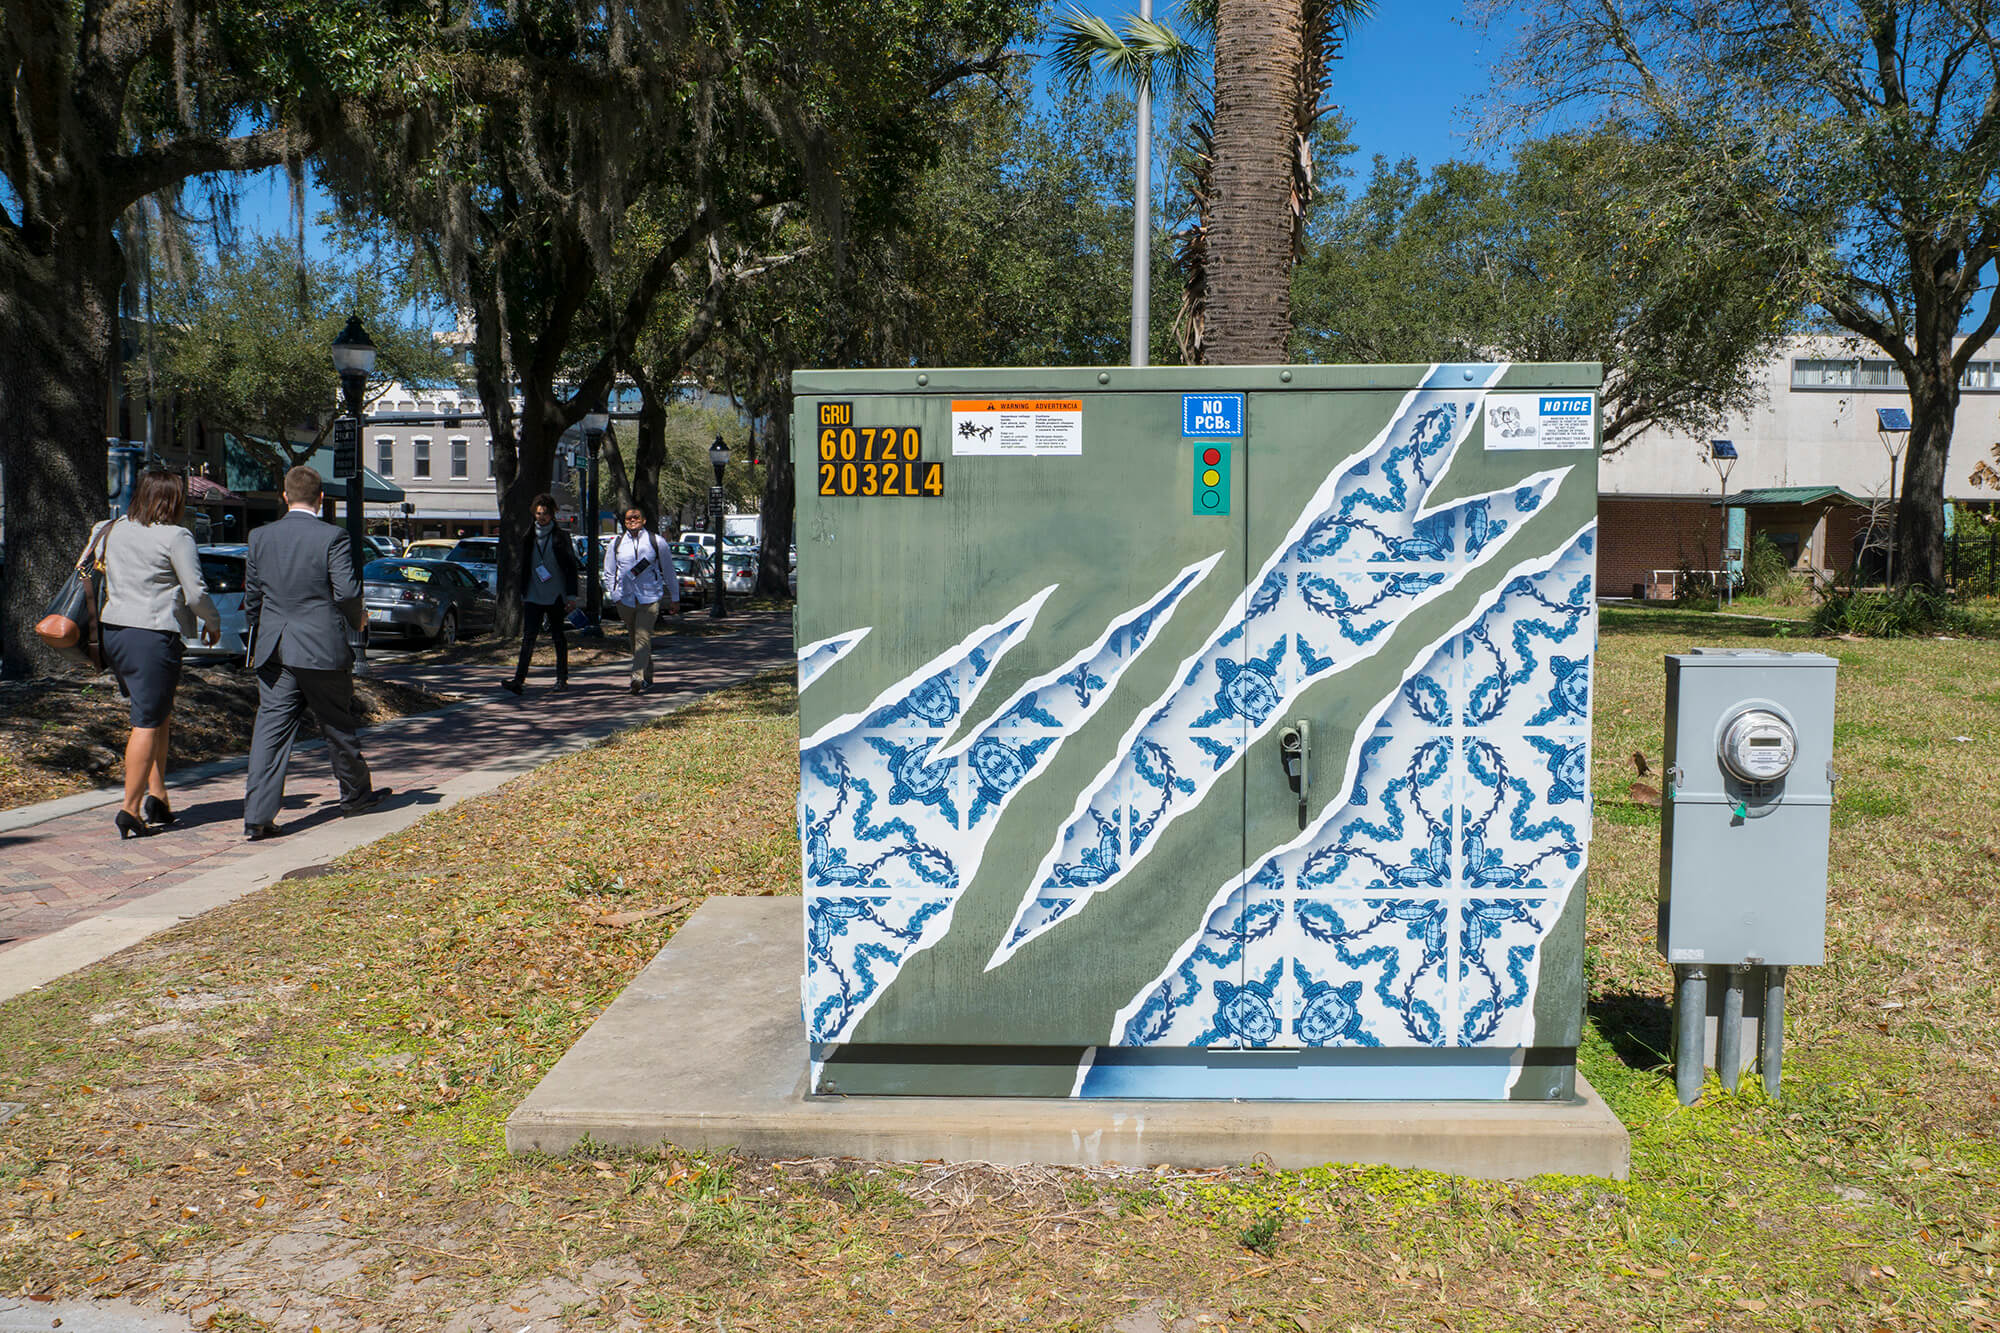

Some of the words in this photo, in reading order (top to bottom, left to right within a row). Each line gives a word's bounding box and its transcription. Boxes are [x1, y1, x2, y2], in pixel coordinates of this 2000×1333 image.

[1202, 400, 1223, 414] NO
[1543, 400, 1589, 412] NOTICE
[820, 404, 850, 425] GRU
[1195, 415, 1231, 430] PCBs
[820, 428, 919, 461] 60720
